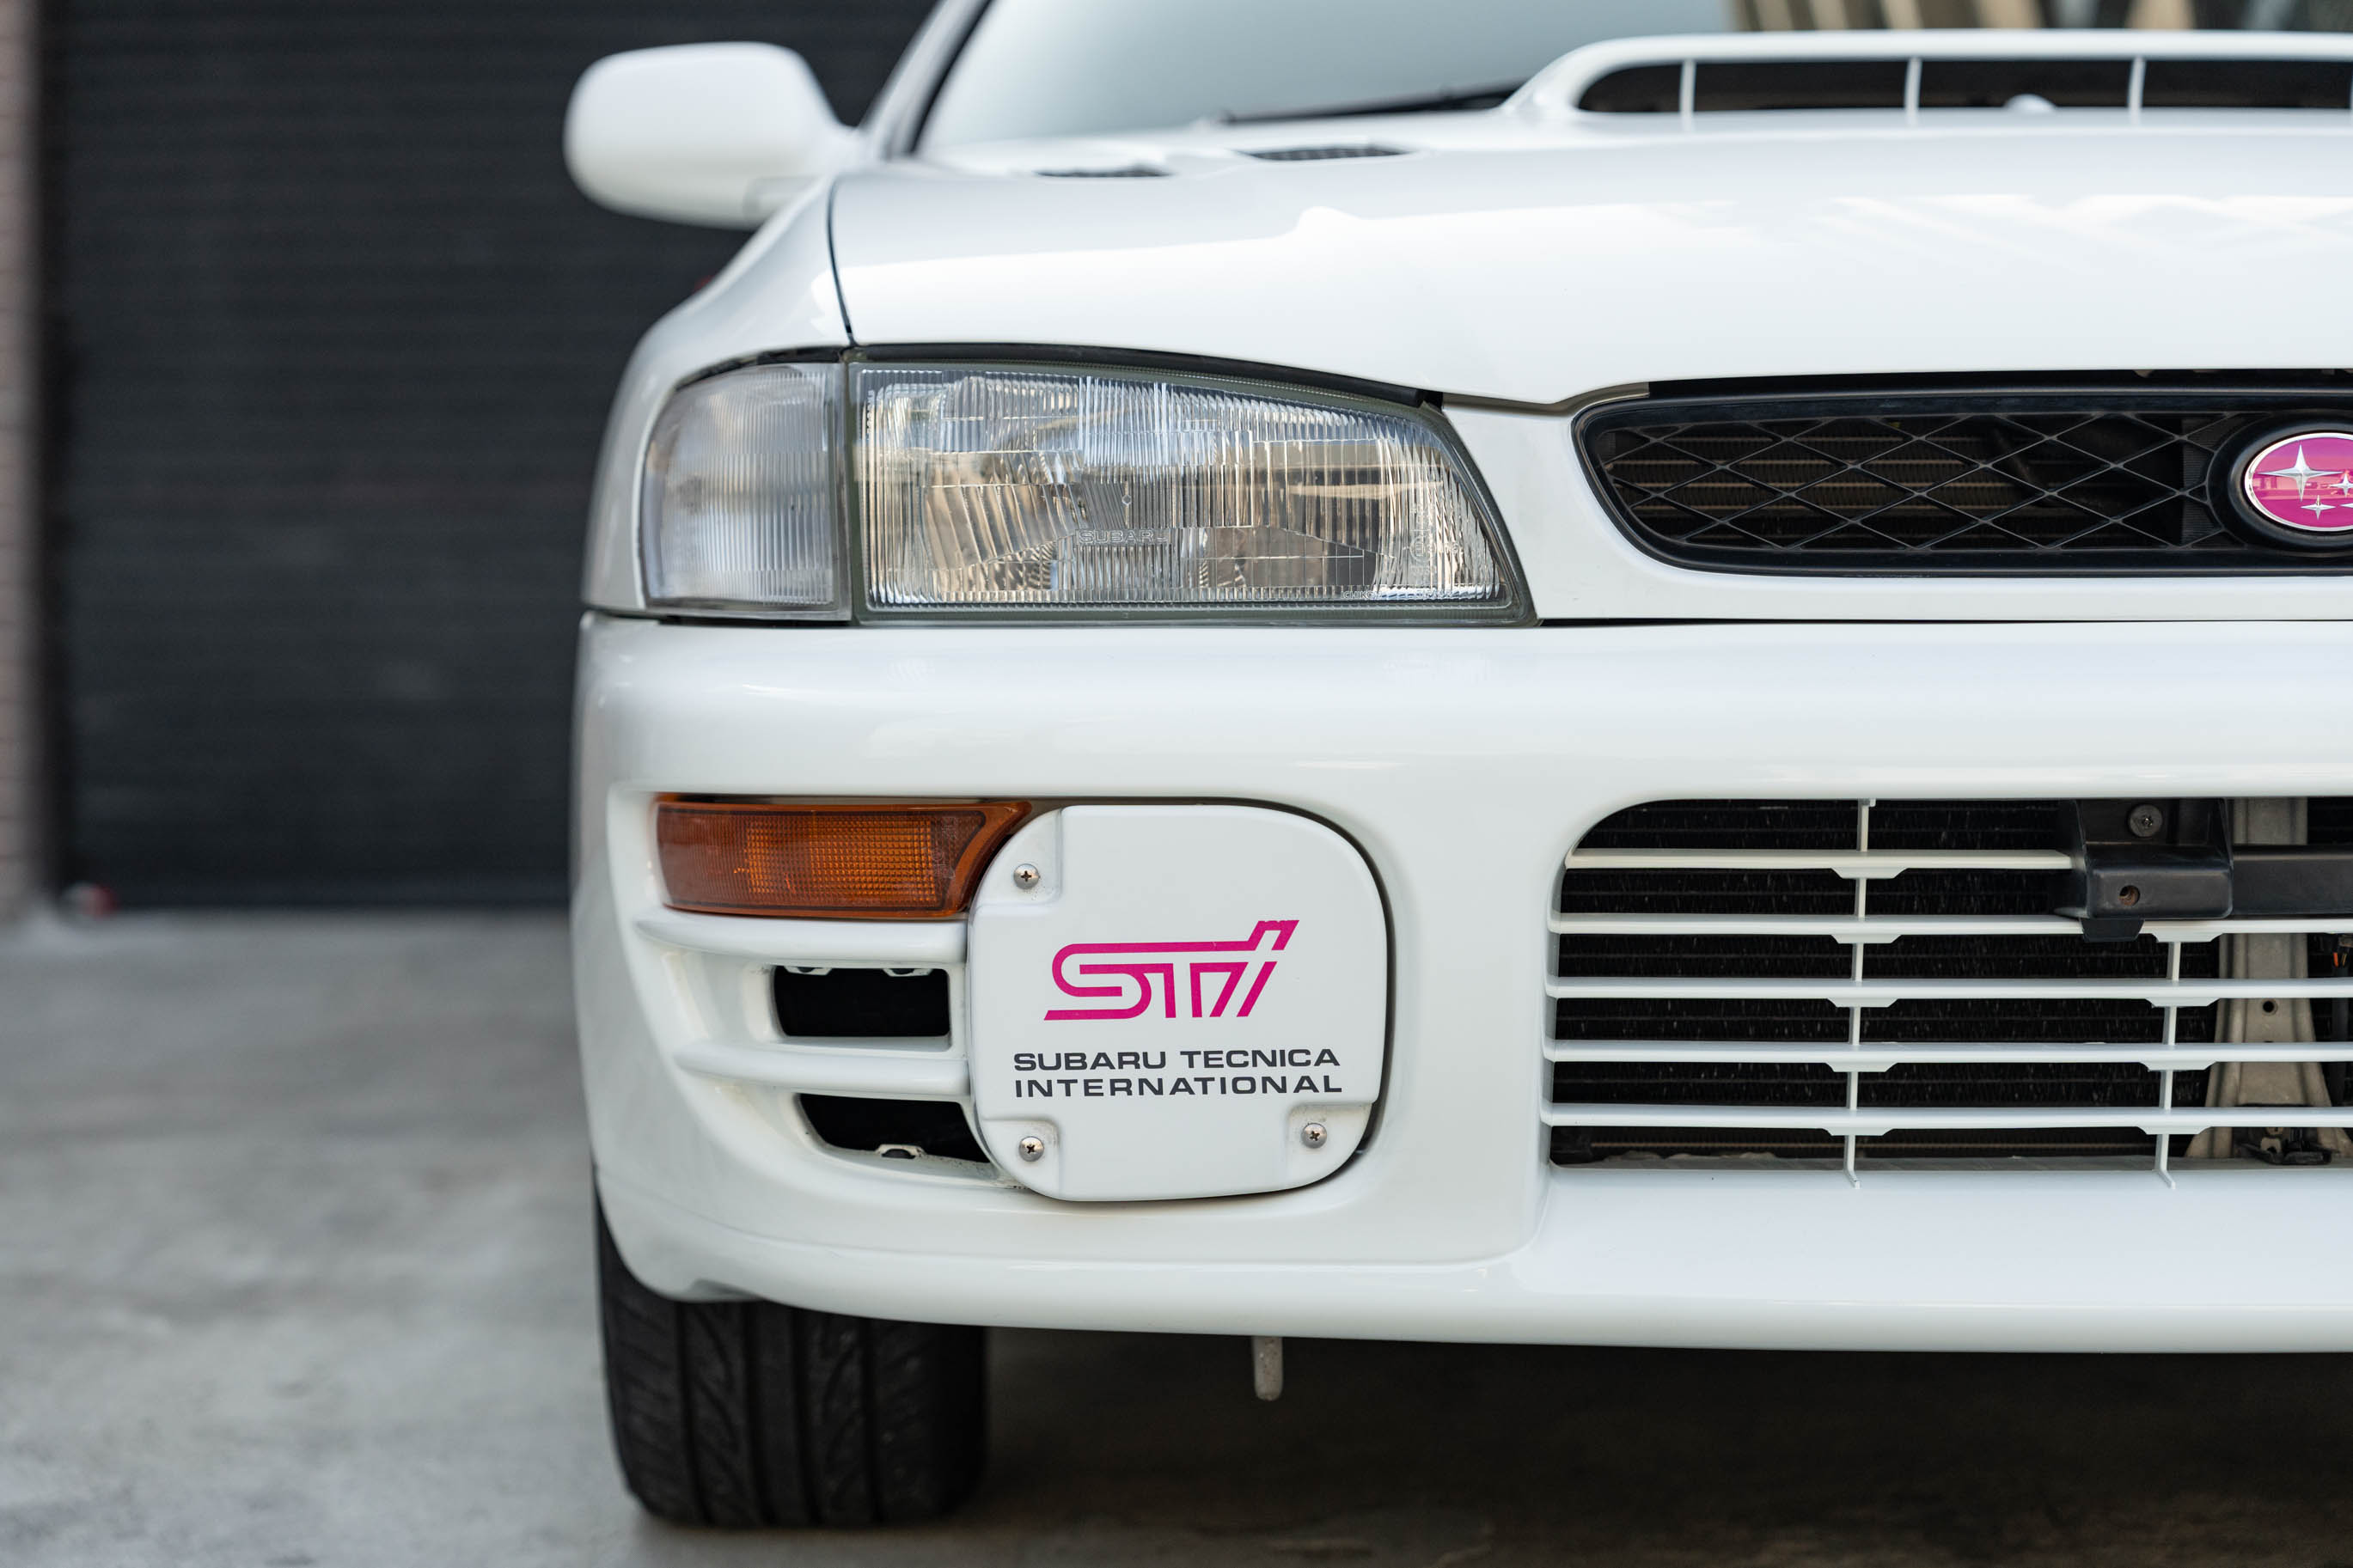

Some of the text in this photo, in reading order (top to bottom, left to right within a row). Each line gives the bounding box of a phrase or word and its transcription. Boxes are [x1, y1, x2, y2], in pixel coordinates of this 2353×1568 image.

[1013, 1048, 1341, 1071] SUBARU TECNICA
[1015, 1075, 1342, 1097] INTERNATIONAL
